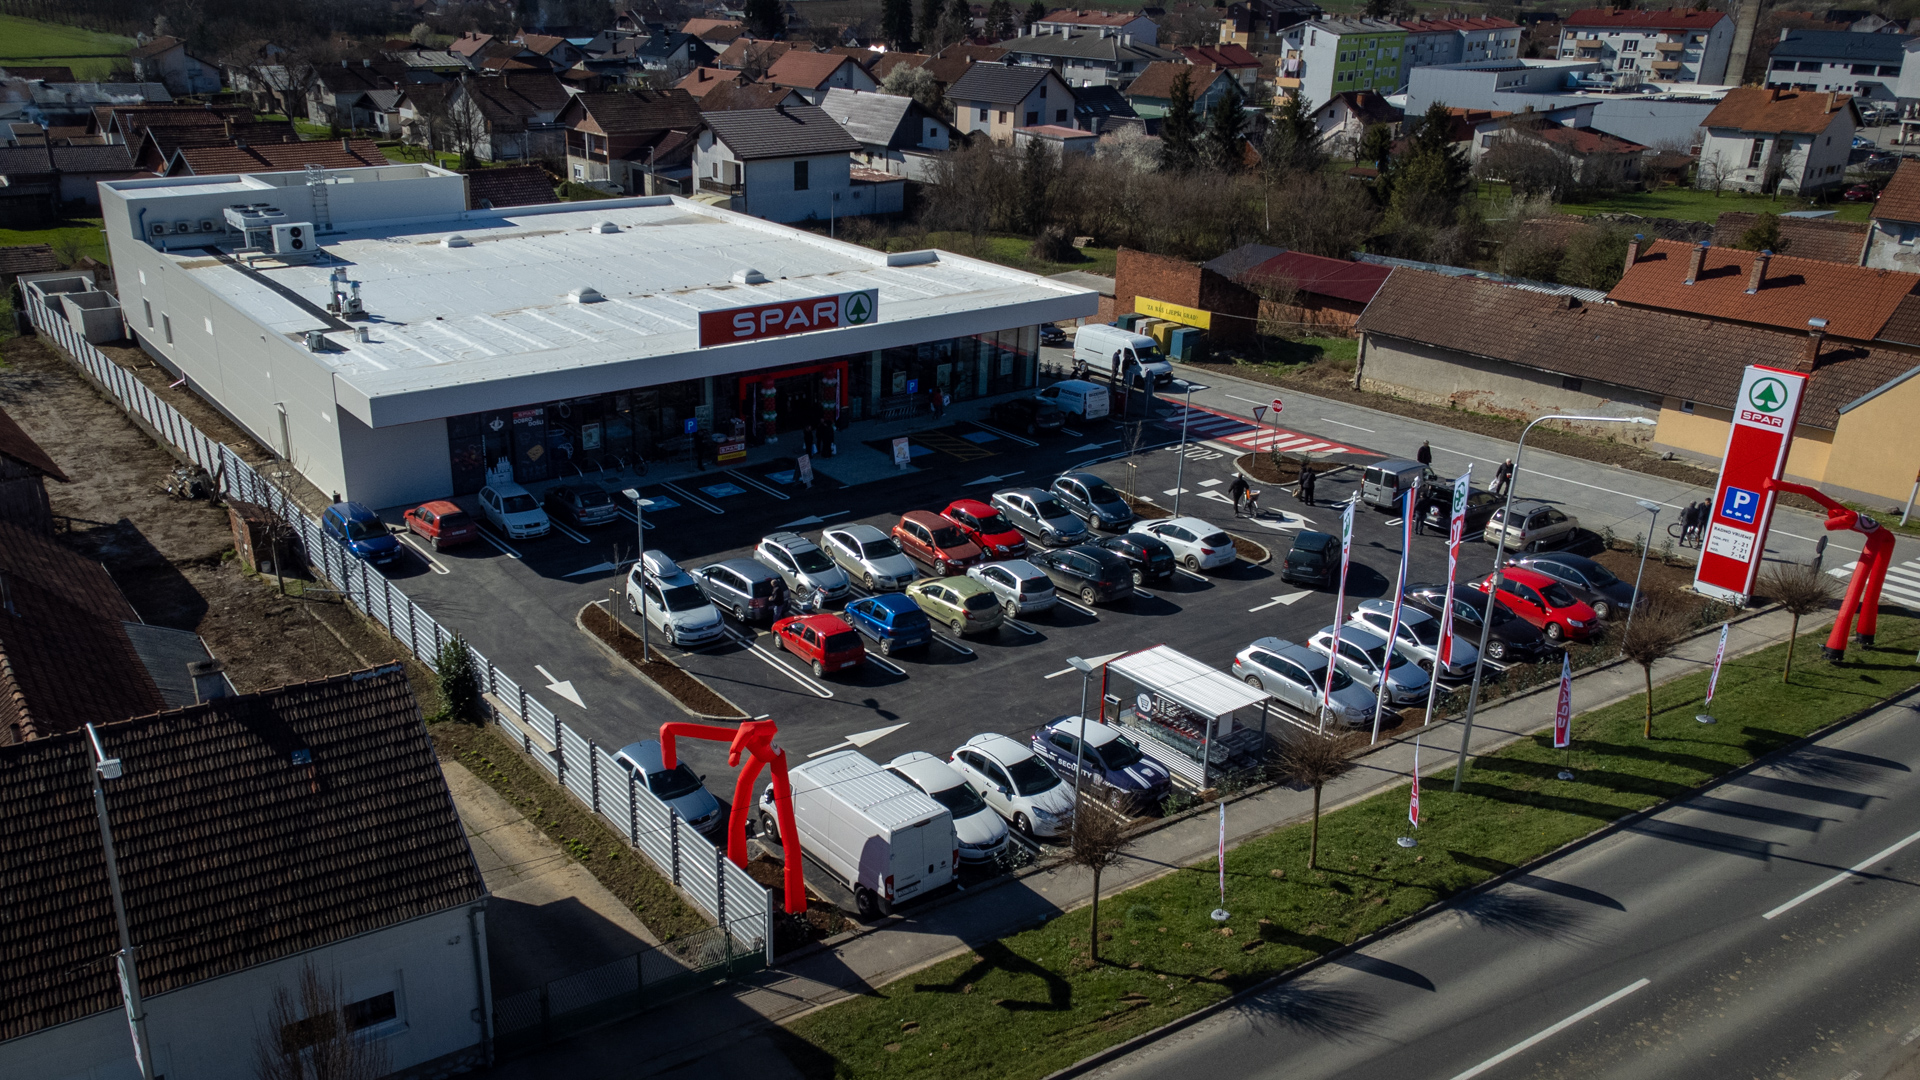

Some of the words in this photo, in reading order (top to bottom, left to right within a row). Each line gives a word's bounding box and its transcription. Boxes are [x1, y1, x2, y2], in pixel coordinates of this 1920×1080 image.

[732, 300, 837, 337] SPAR
[1272, 402, 1283, 410] STOP
[512, 416, 533, 425] DOBRO
[527, 418, 544, 427] DOŠLI
[1742, 411, 1783, 427] SPAR
[1164, 443, 1224, 461] STOP
[1733, 490, 1751, 509] P
[1714, 526, 1731, 534] RADNO
[1732, 531, 1752, 540] VRIJEME
[1057, 757, 1093, 779] SECUITY
